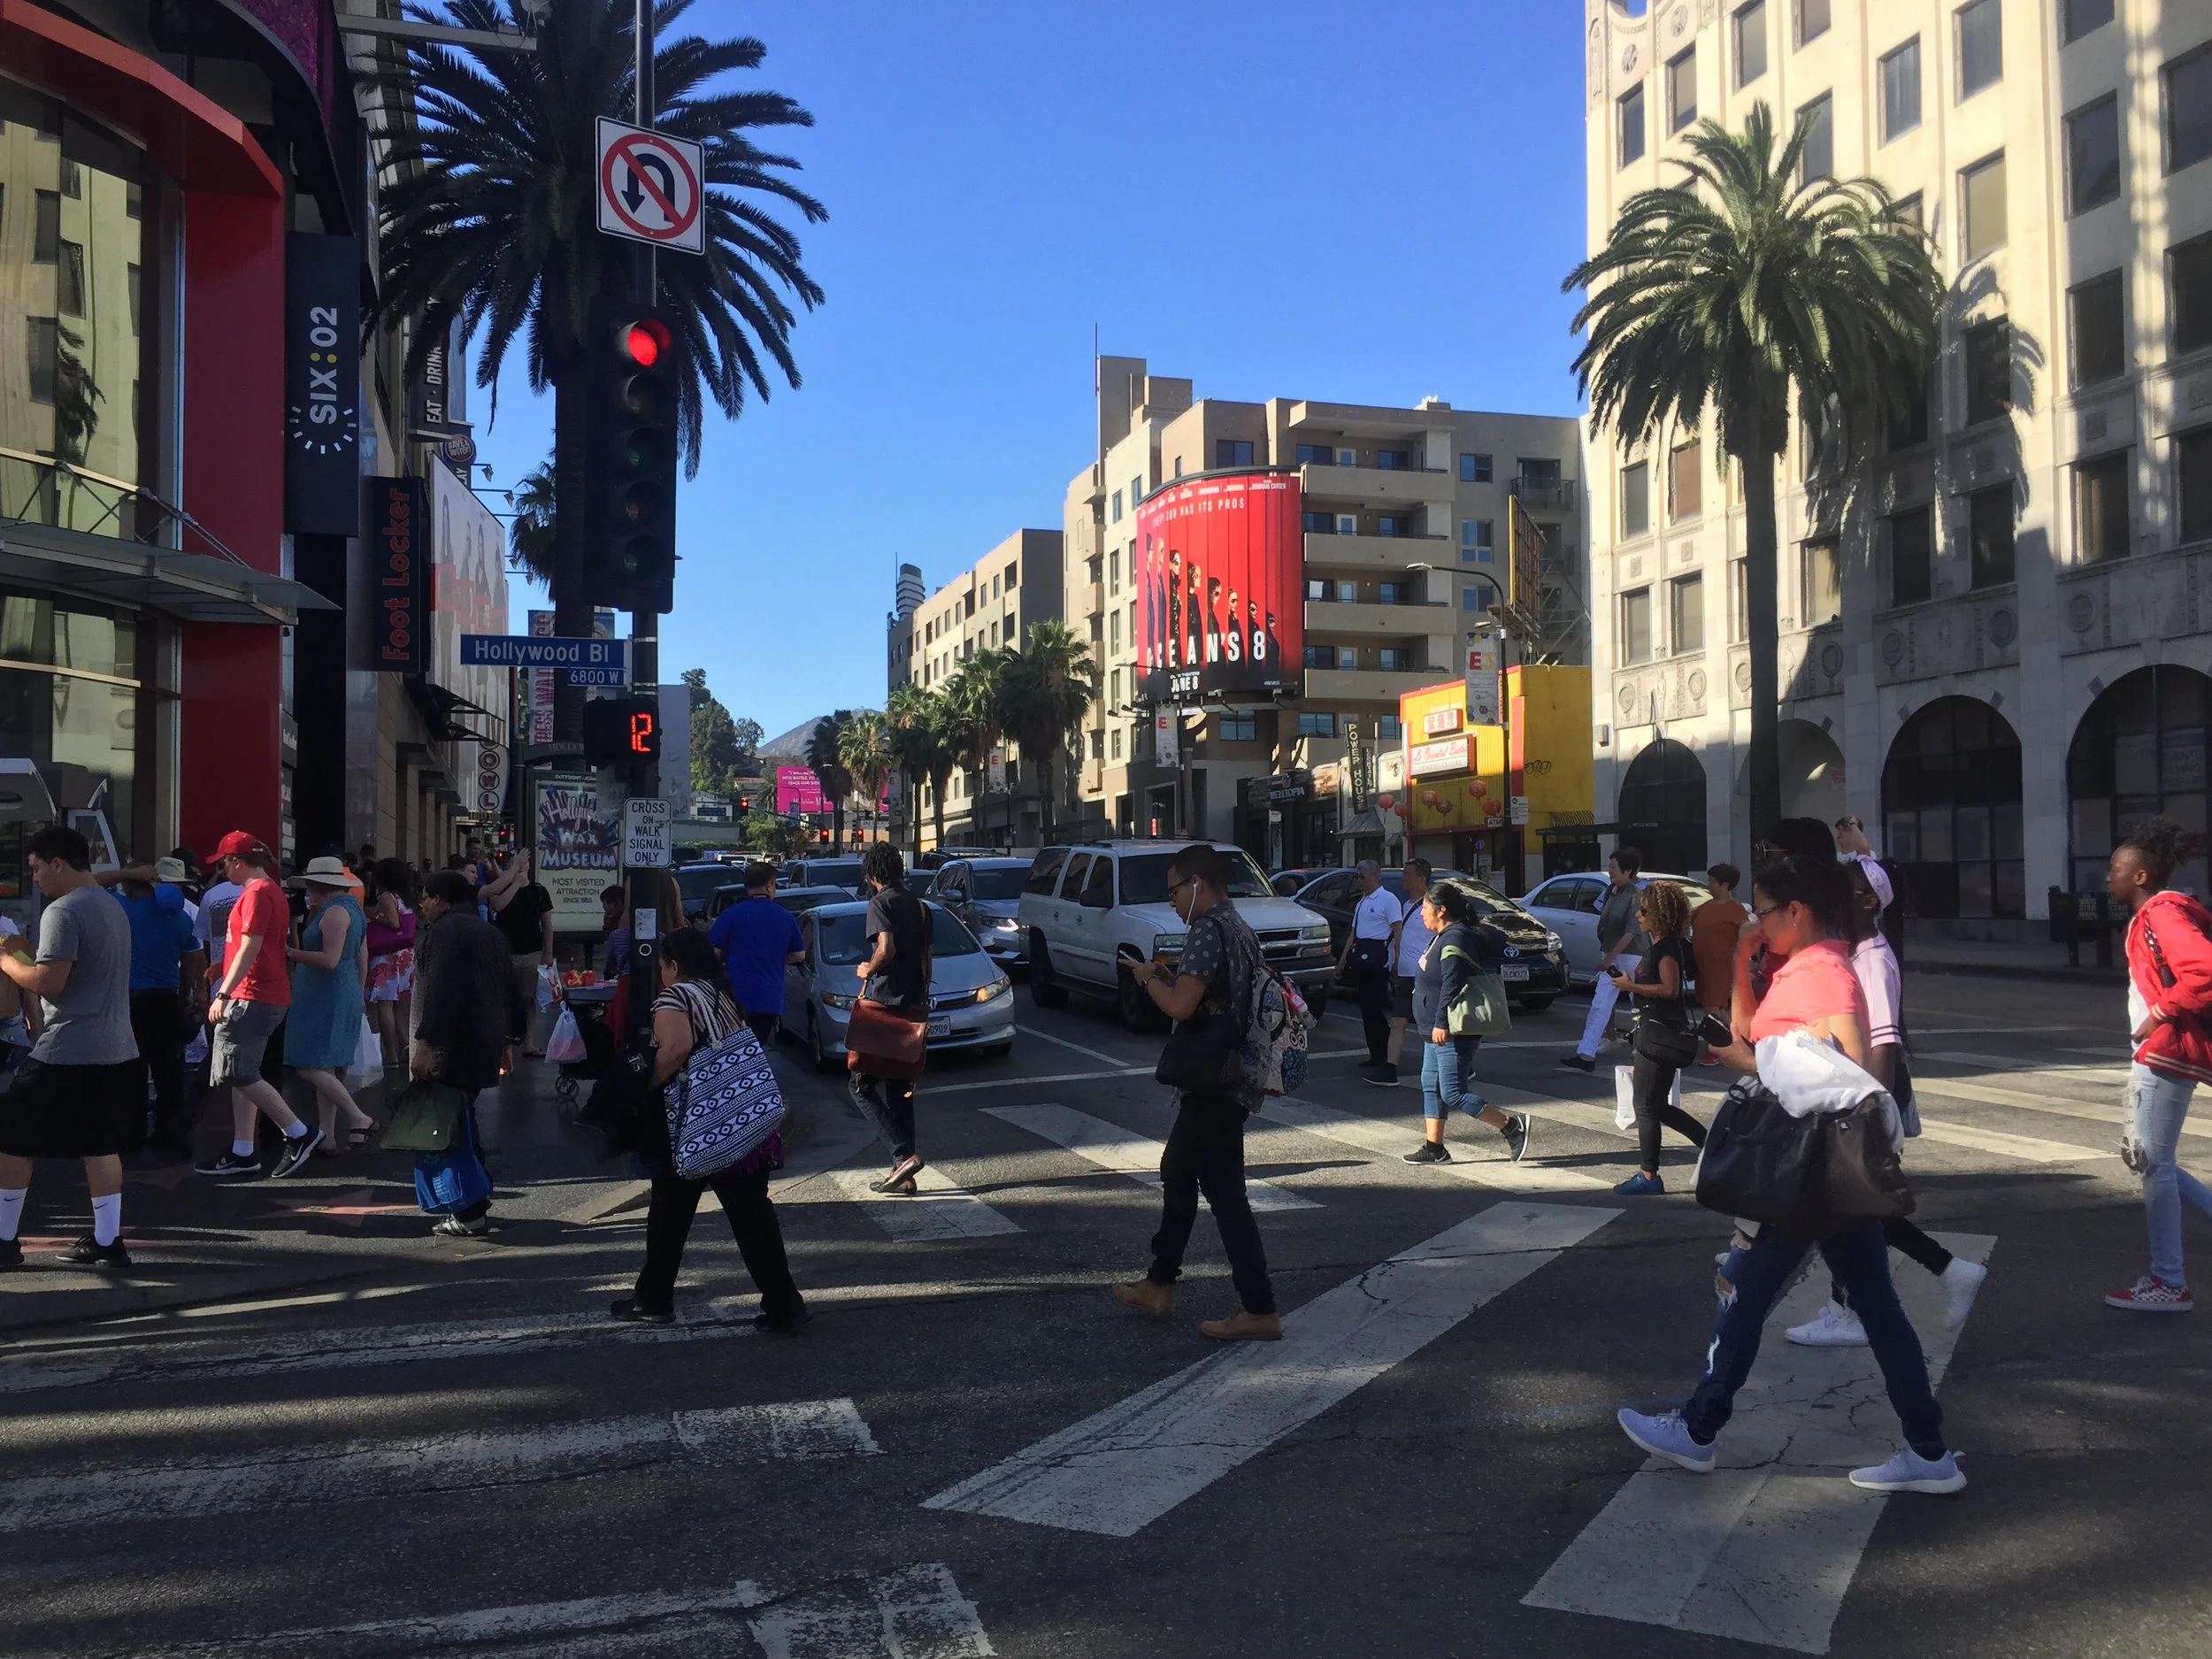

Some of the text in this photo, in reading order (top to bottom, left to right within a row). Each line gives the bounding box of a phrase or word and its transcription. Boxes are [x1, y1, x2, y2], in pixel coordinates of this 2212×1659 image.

[310, 306, 337, 425] SIX:02
[426, 399, 442, 424] EAT
[1179, 504, 1194, 518] HAS
[1198, 501, 1213, 513] ITS
[1217, 497, 1245, 511] PROS
[382, 488, 410, 660] Foot Locker
[474, 640, 609, 665] Hollywood Bl
[1147, 630, 1265, 676] OCEAN'S 8
[1470, 651, 1494, 671] E3
[570, 670, 619, 684] 6800 W
[1171, 676, 1191, 694] JUNE
[1192, 675, 1199, 690] 8
[631, 712, 652, 753] 12
[1348, 723, 1365, 810] POWER HOUSE
[632, 802, 664, 814] CROSS
[642, 815, 654, 824] ON
[634, 826, 661, 837] WALK
[629, 838, 664, 850] SIGNAL
[542, 849, 617, 868] MUSEUM
[634, 851, 659, 863] ONLY
